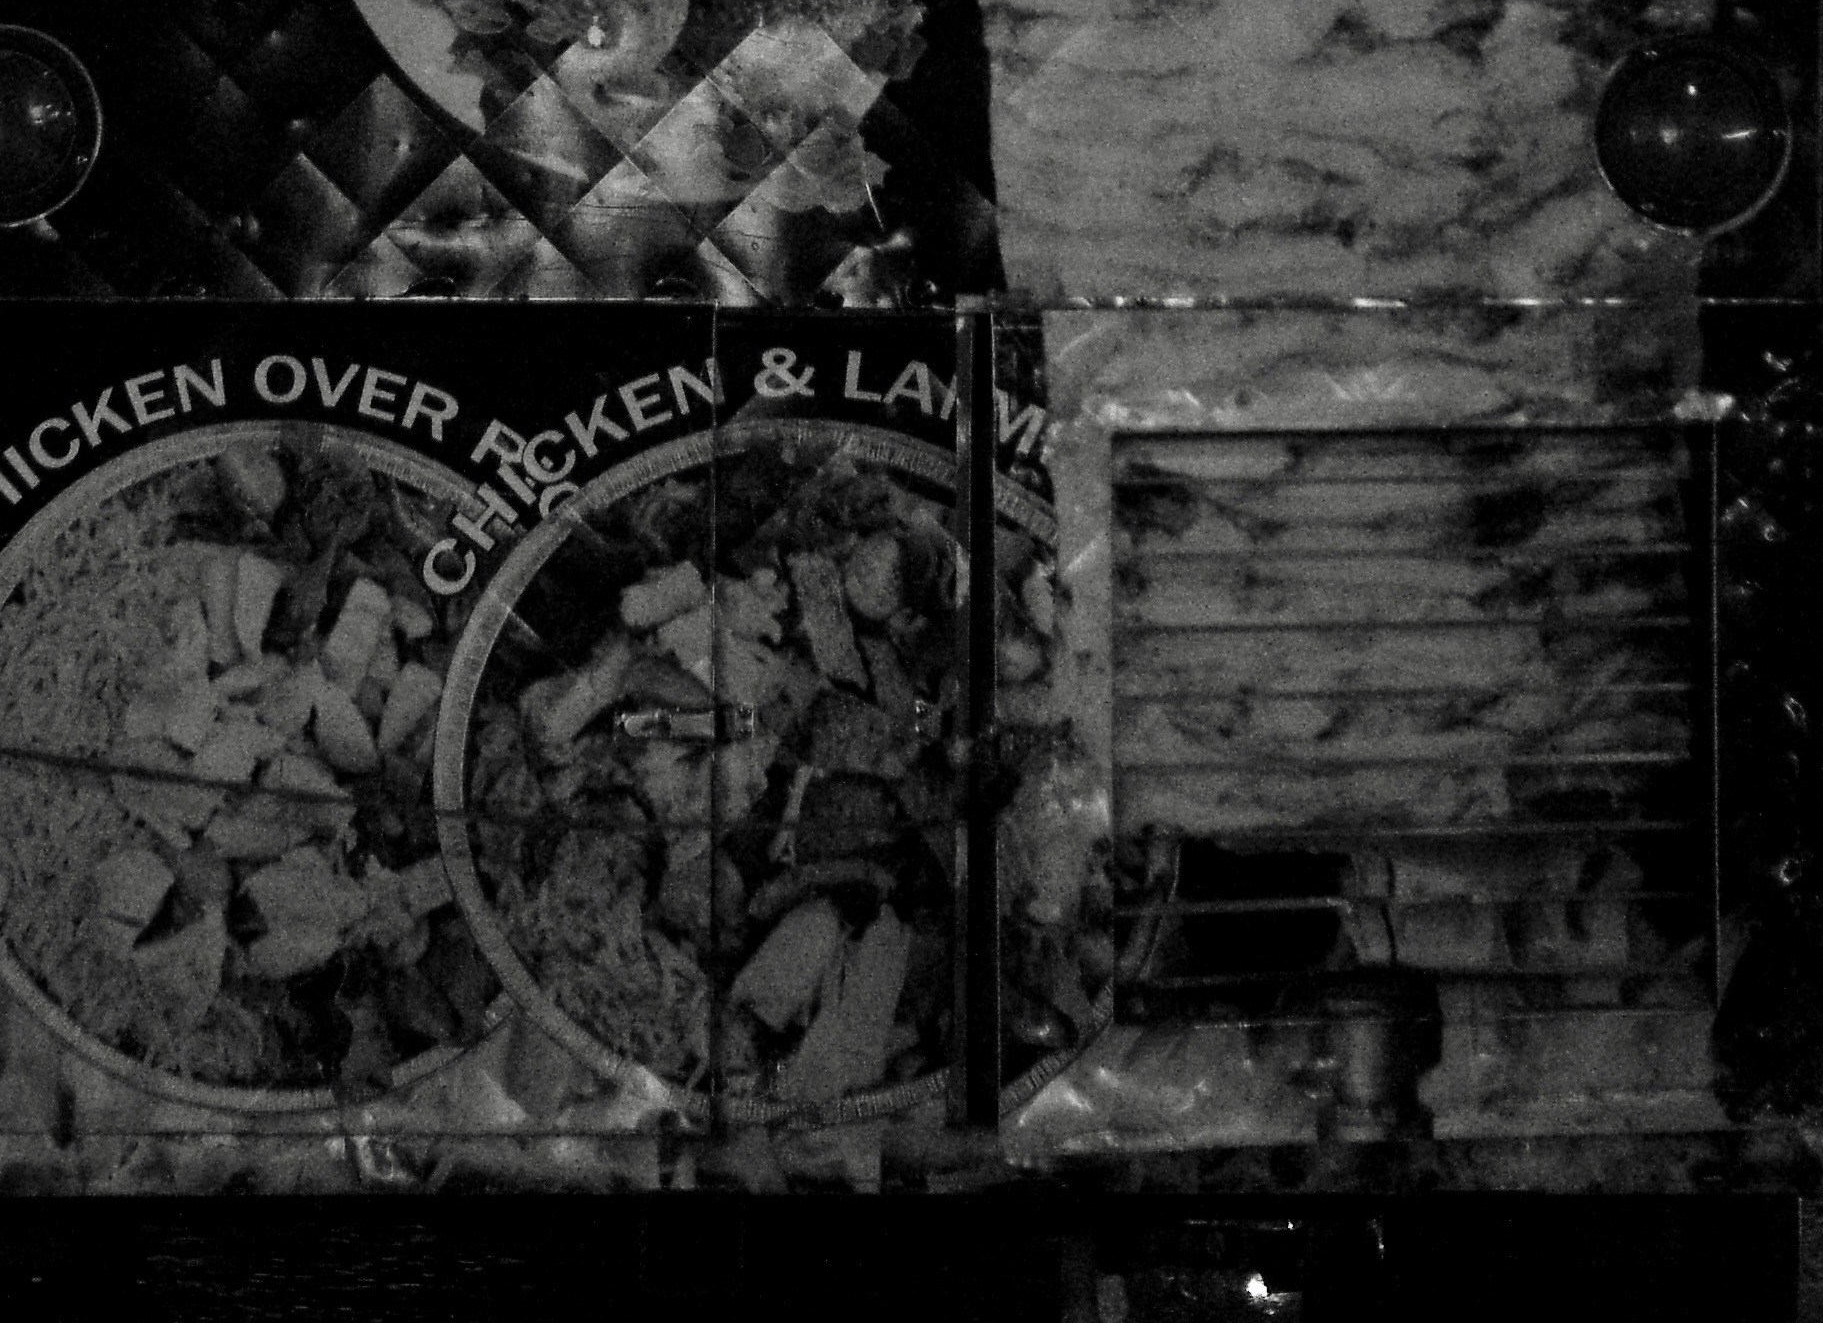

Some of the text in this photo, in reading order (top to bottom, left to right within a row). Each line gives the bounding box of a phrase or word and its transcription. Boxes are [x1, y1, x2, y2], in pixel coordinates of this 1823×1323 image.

[254, 354, 460, 441] OVER
[422, 357, 725, 596] CHICKEN
[754, 346, 817, 398] &
